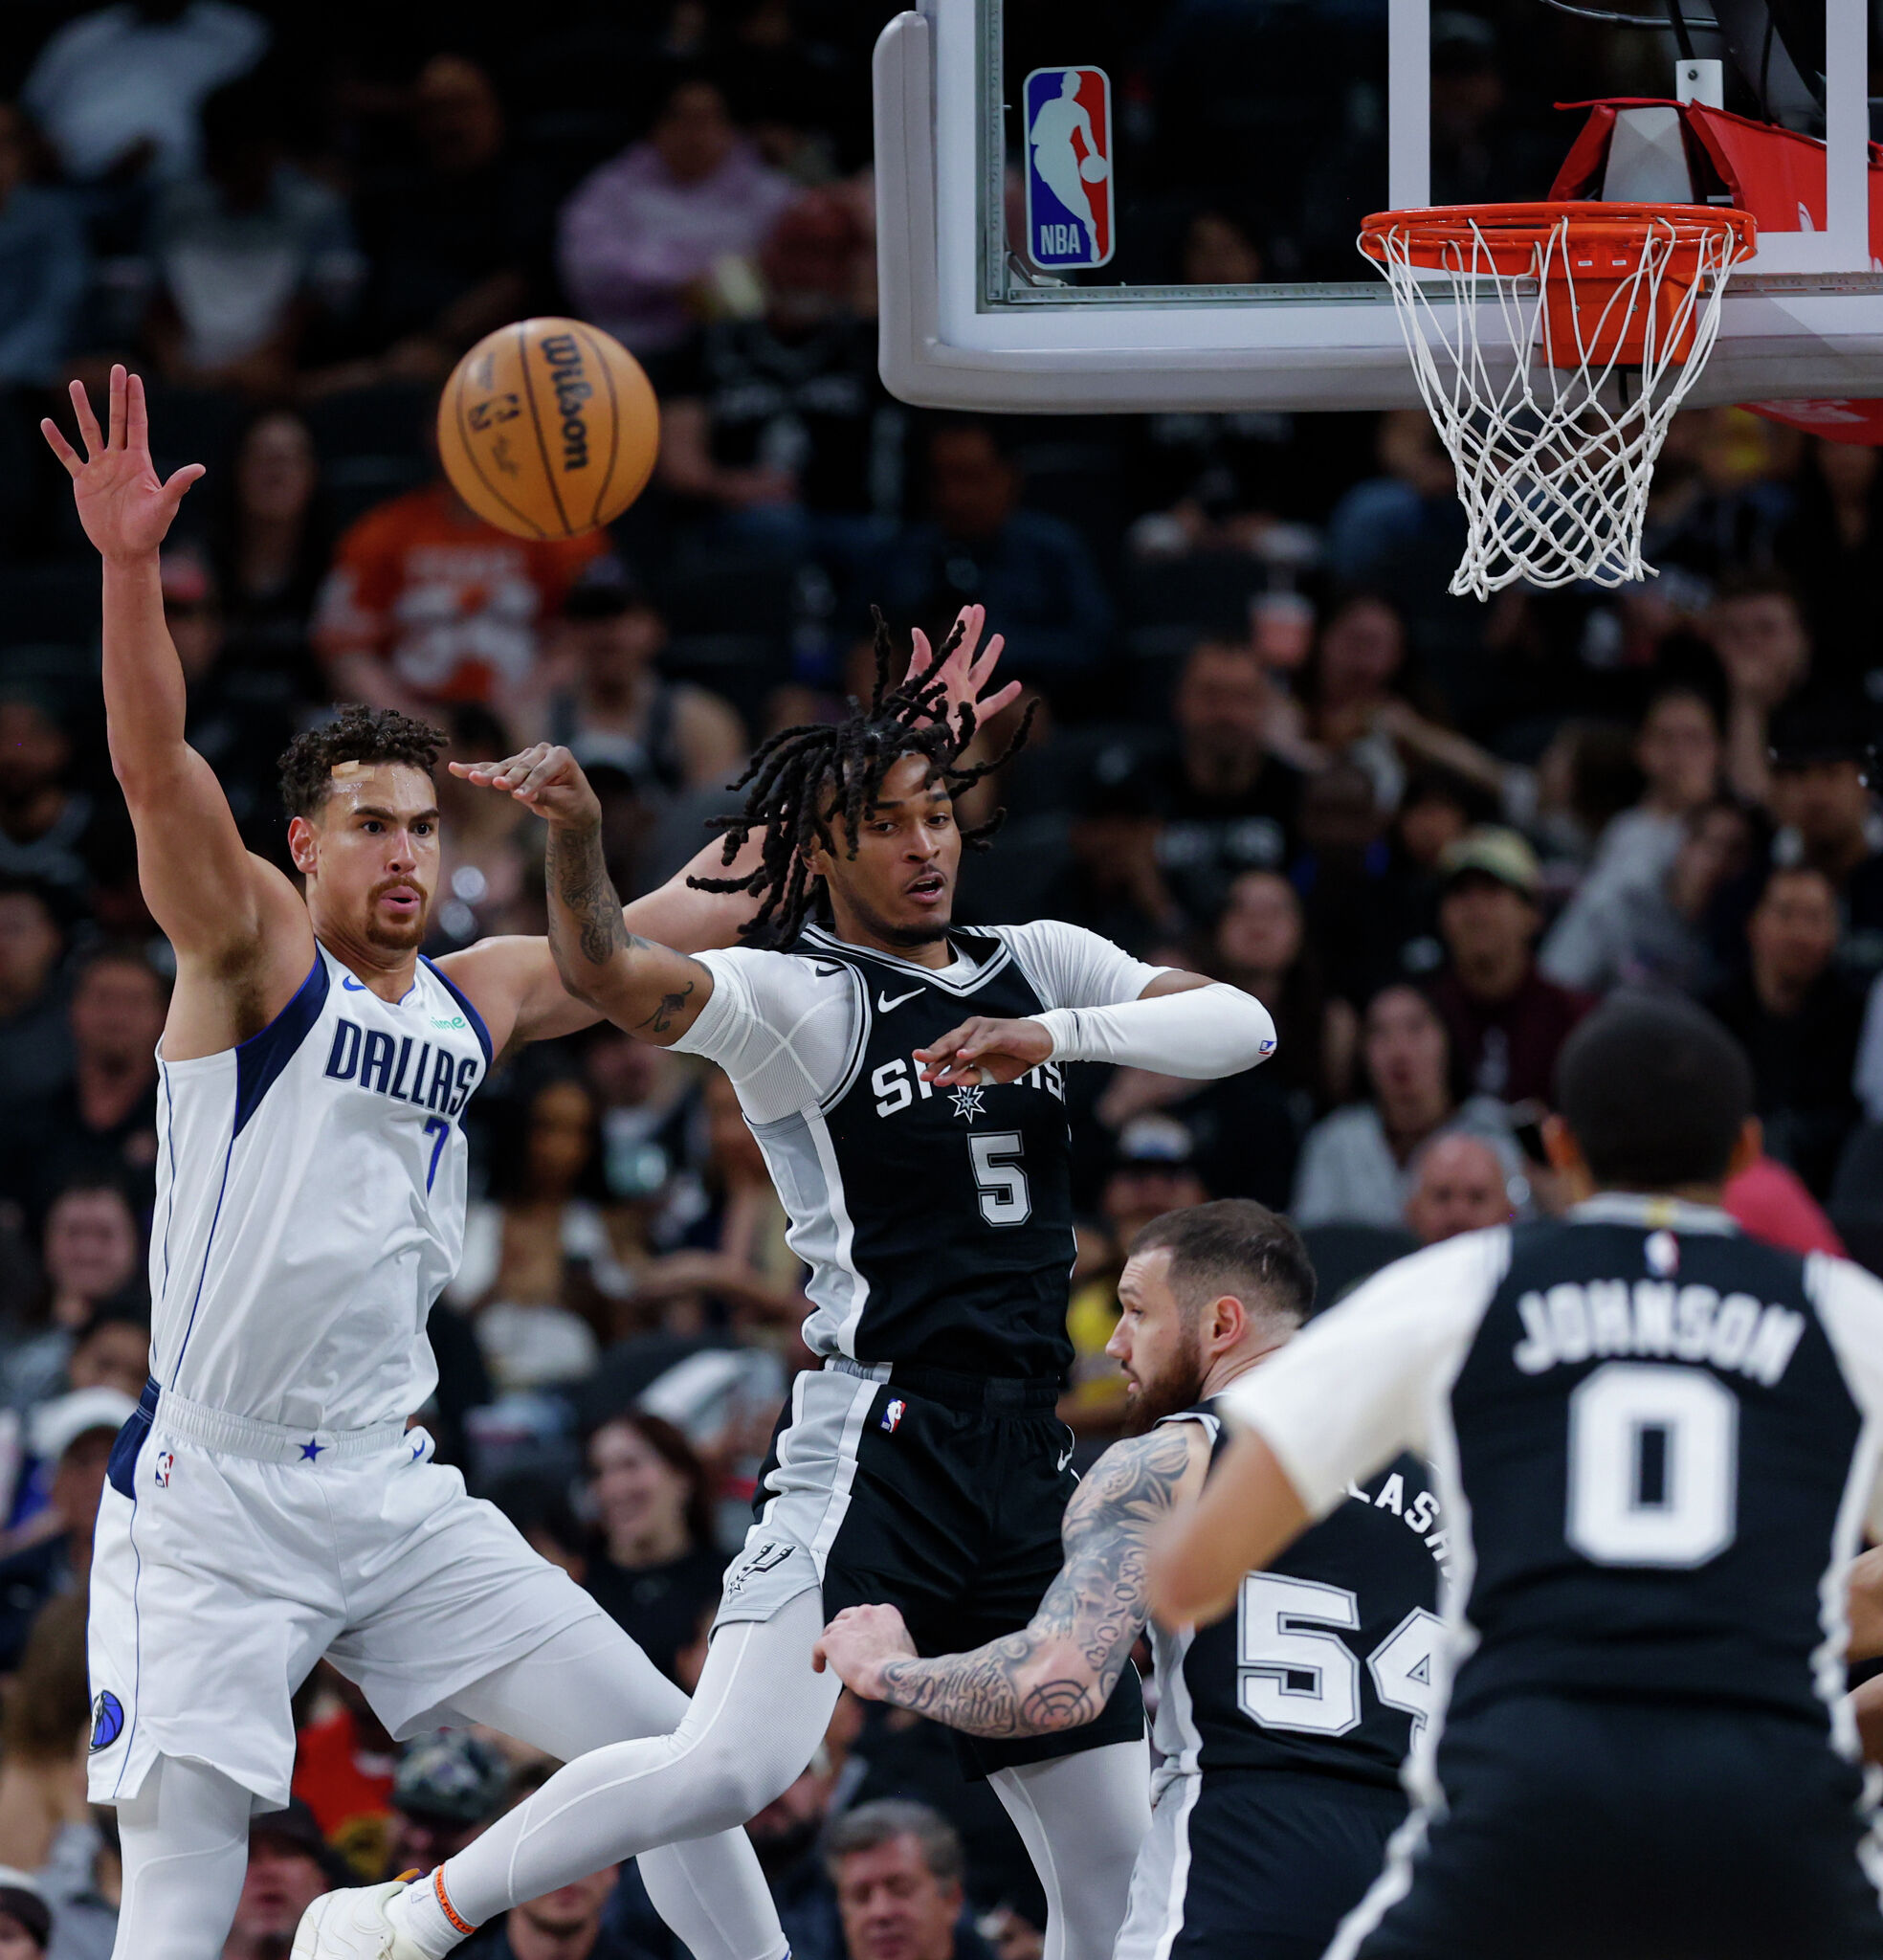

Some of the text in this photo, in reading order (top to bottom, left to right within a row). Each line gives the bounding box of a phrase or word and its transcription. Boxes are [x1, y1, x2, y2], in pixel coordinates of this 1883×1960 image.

[1040, 223, 1082, 256] NBA
[540, 334, 594, 473] Wilson
[322, 1015, 478, 1119] DALLAS
[422, 1114, 452, 1200] 7
[966, 1129, 1032, 1227] 5
[1512, 1278, 1806, 1387] JOHNSON
[1564, 1360, 1740, 1570] 0
[1237, 1570, 1445, 1757] 54
